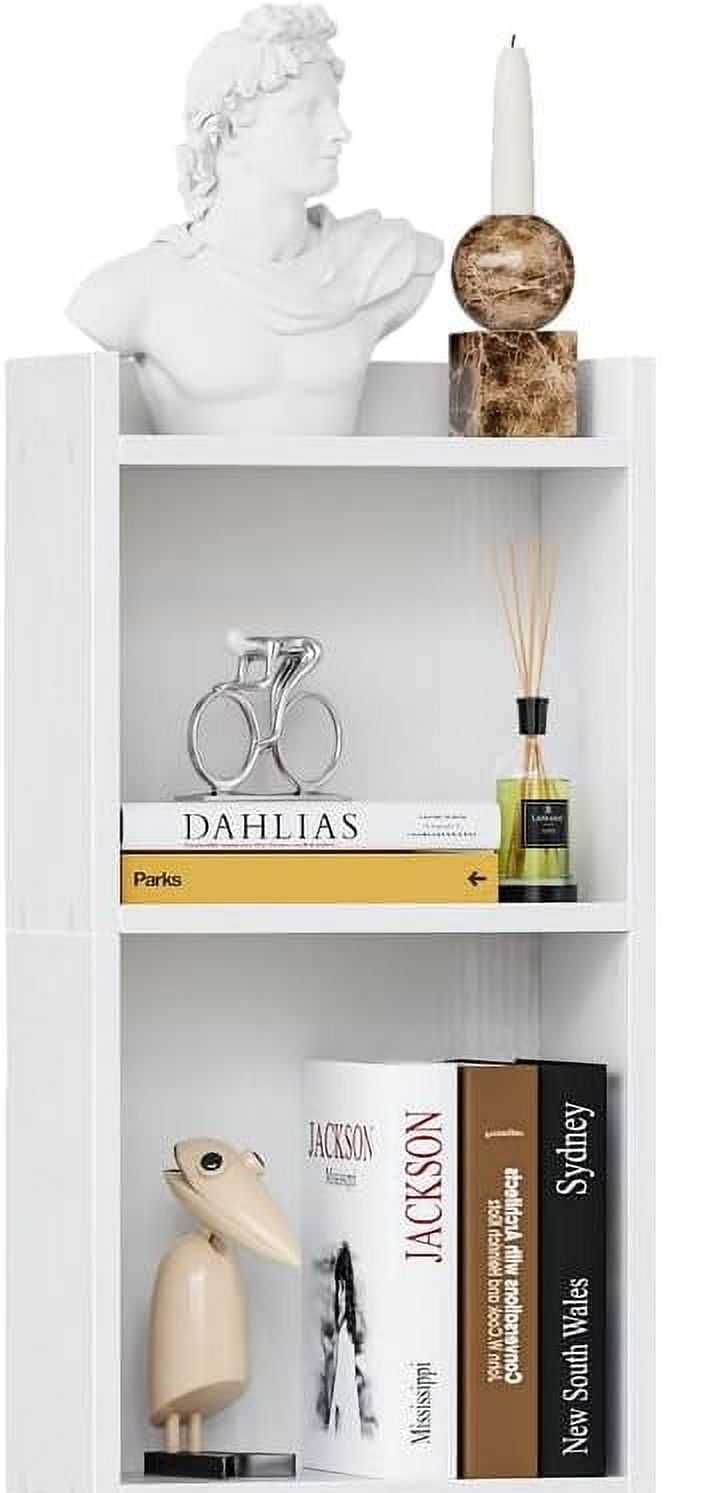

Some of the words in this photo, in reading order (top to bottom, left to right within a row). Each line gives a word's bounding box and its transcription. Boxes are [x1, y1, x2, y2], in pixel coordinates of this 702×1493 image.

[182, 812, 358, 840] DAHLIAS
[133, 871, 182, 888] Parks
[308, 1121, 374, 1162] JACKSON
[557, 1101, 595, 1196] Sydney
[405, 1110, 443, 1263] JACKSON
[562, 1277, 588, 1338] Wales
[562, 1347, 588, 1402] South
[410, 1361, 438, 1445] Mississippi
[562, 1407, 588, 1457] New
